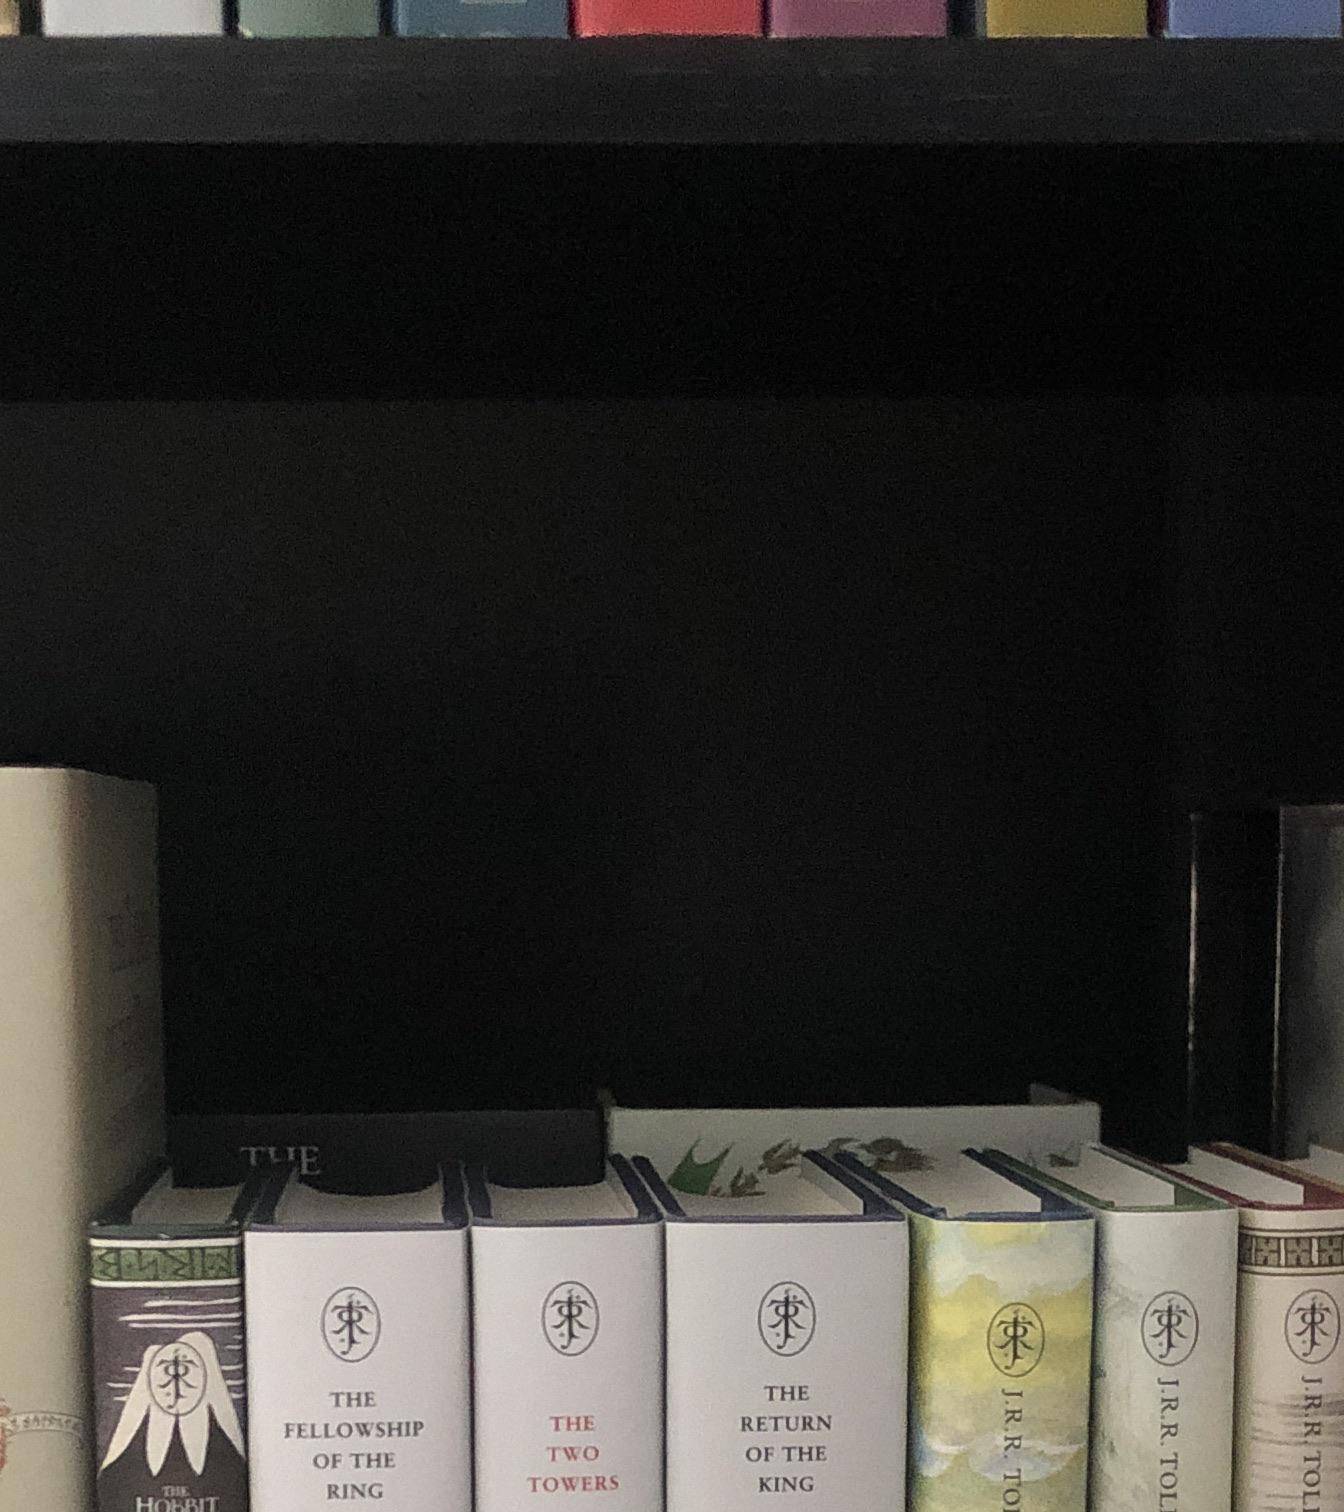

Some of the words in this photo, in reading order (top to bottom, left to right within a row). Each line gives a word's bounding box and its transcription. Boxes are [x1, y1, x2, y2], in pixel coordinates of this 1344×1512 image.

[329, 1390, 376, 1409] THE
[764, 1384, 810, 1402] THE
[1157, 1377, 1179, 1446] J.R.R.
[283, 1419, 425, 1441] FELLOWSHIP
[549, 1415, 596, 1433] THE
[739, 1414, 833, 1433] RETURN
[1001, 1388, 1023, 1459] J.R.R.
[313, 1452, 342, 1471] OF
[349, 1451, 396, 1470] THE
[546, 1444, 600, 1463] TWO
[745, 1445, 775, 1464] OF
[781, 1445, 828, 1463] THE
[327, 1482, 384, 1501] RING
[527, 1475, 620, 1494] TOWERS
[757, 1476, 815, 1495] KING
